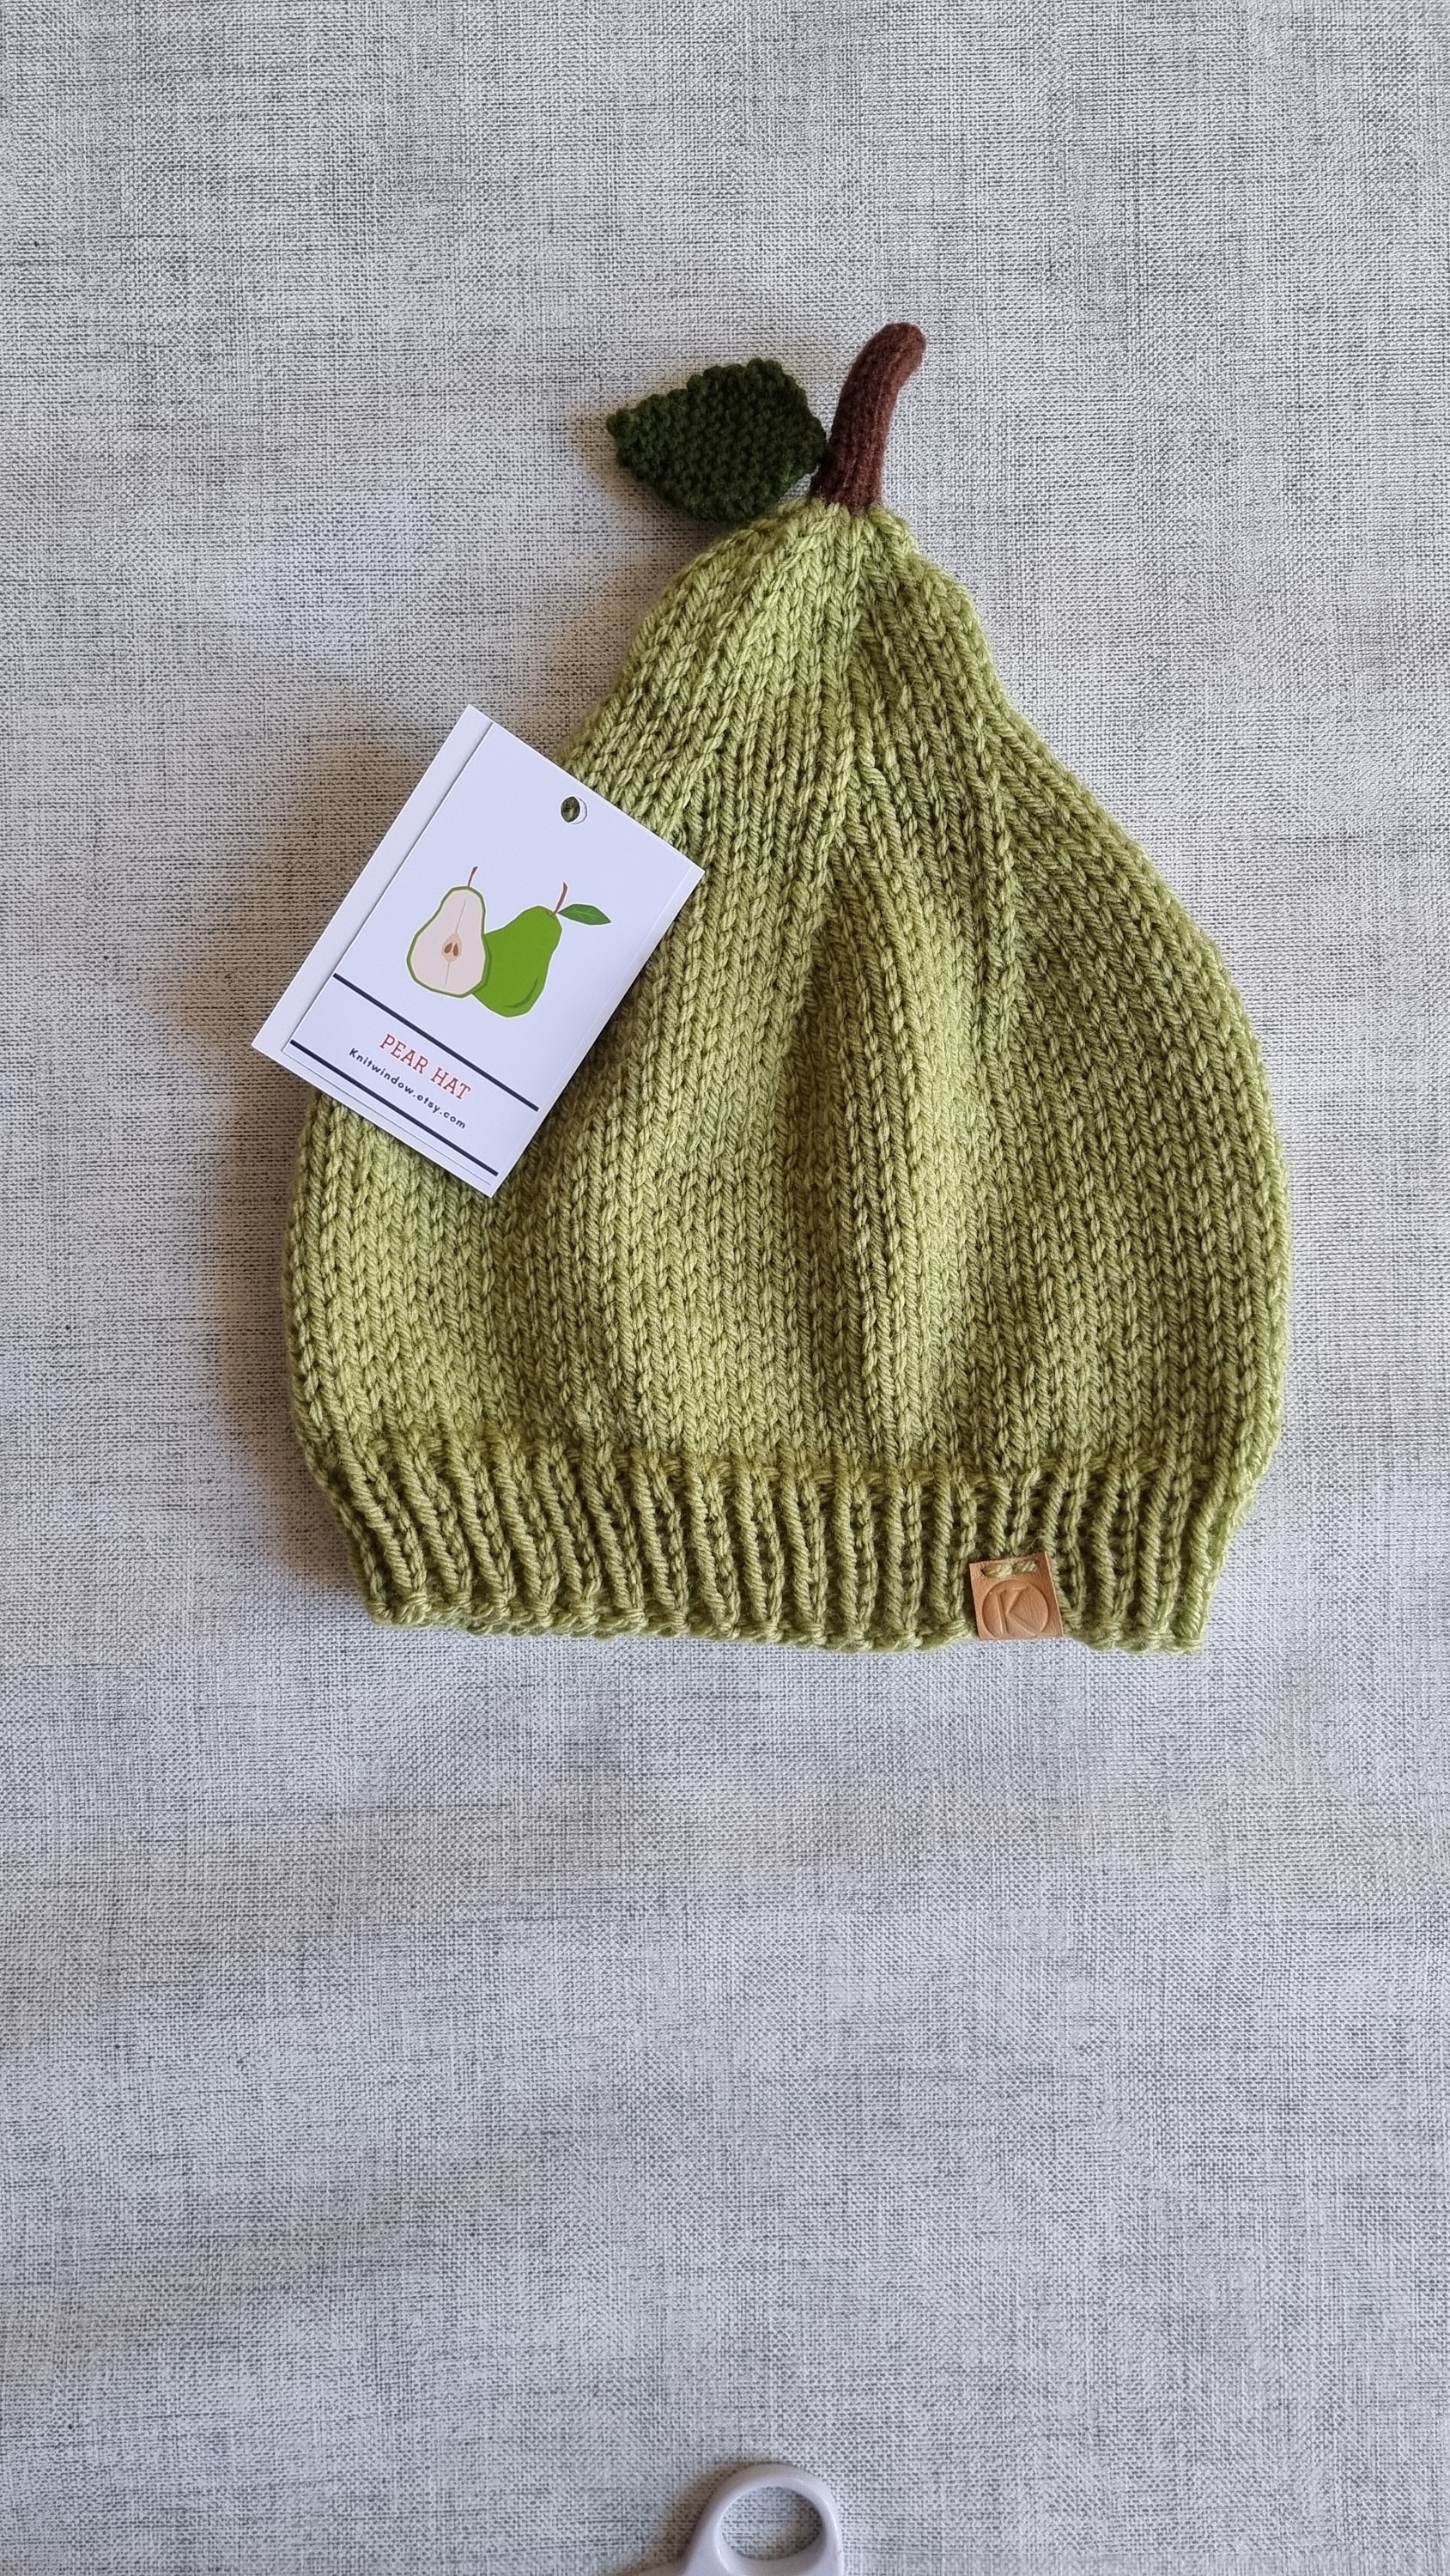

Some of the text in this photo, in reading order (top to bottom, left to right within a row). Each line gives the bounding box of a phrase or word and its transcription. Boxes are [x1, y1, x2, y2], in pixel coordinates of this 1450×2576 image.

[349, 1048, 466, 1129] Knitwindow.etsy.com
[379, 1033, 471, 1100] PEAR HAT
[991, 1587, 1037, 1637] K
